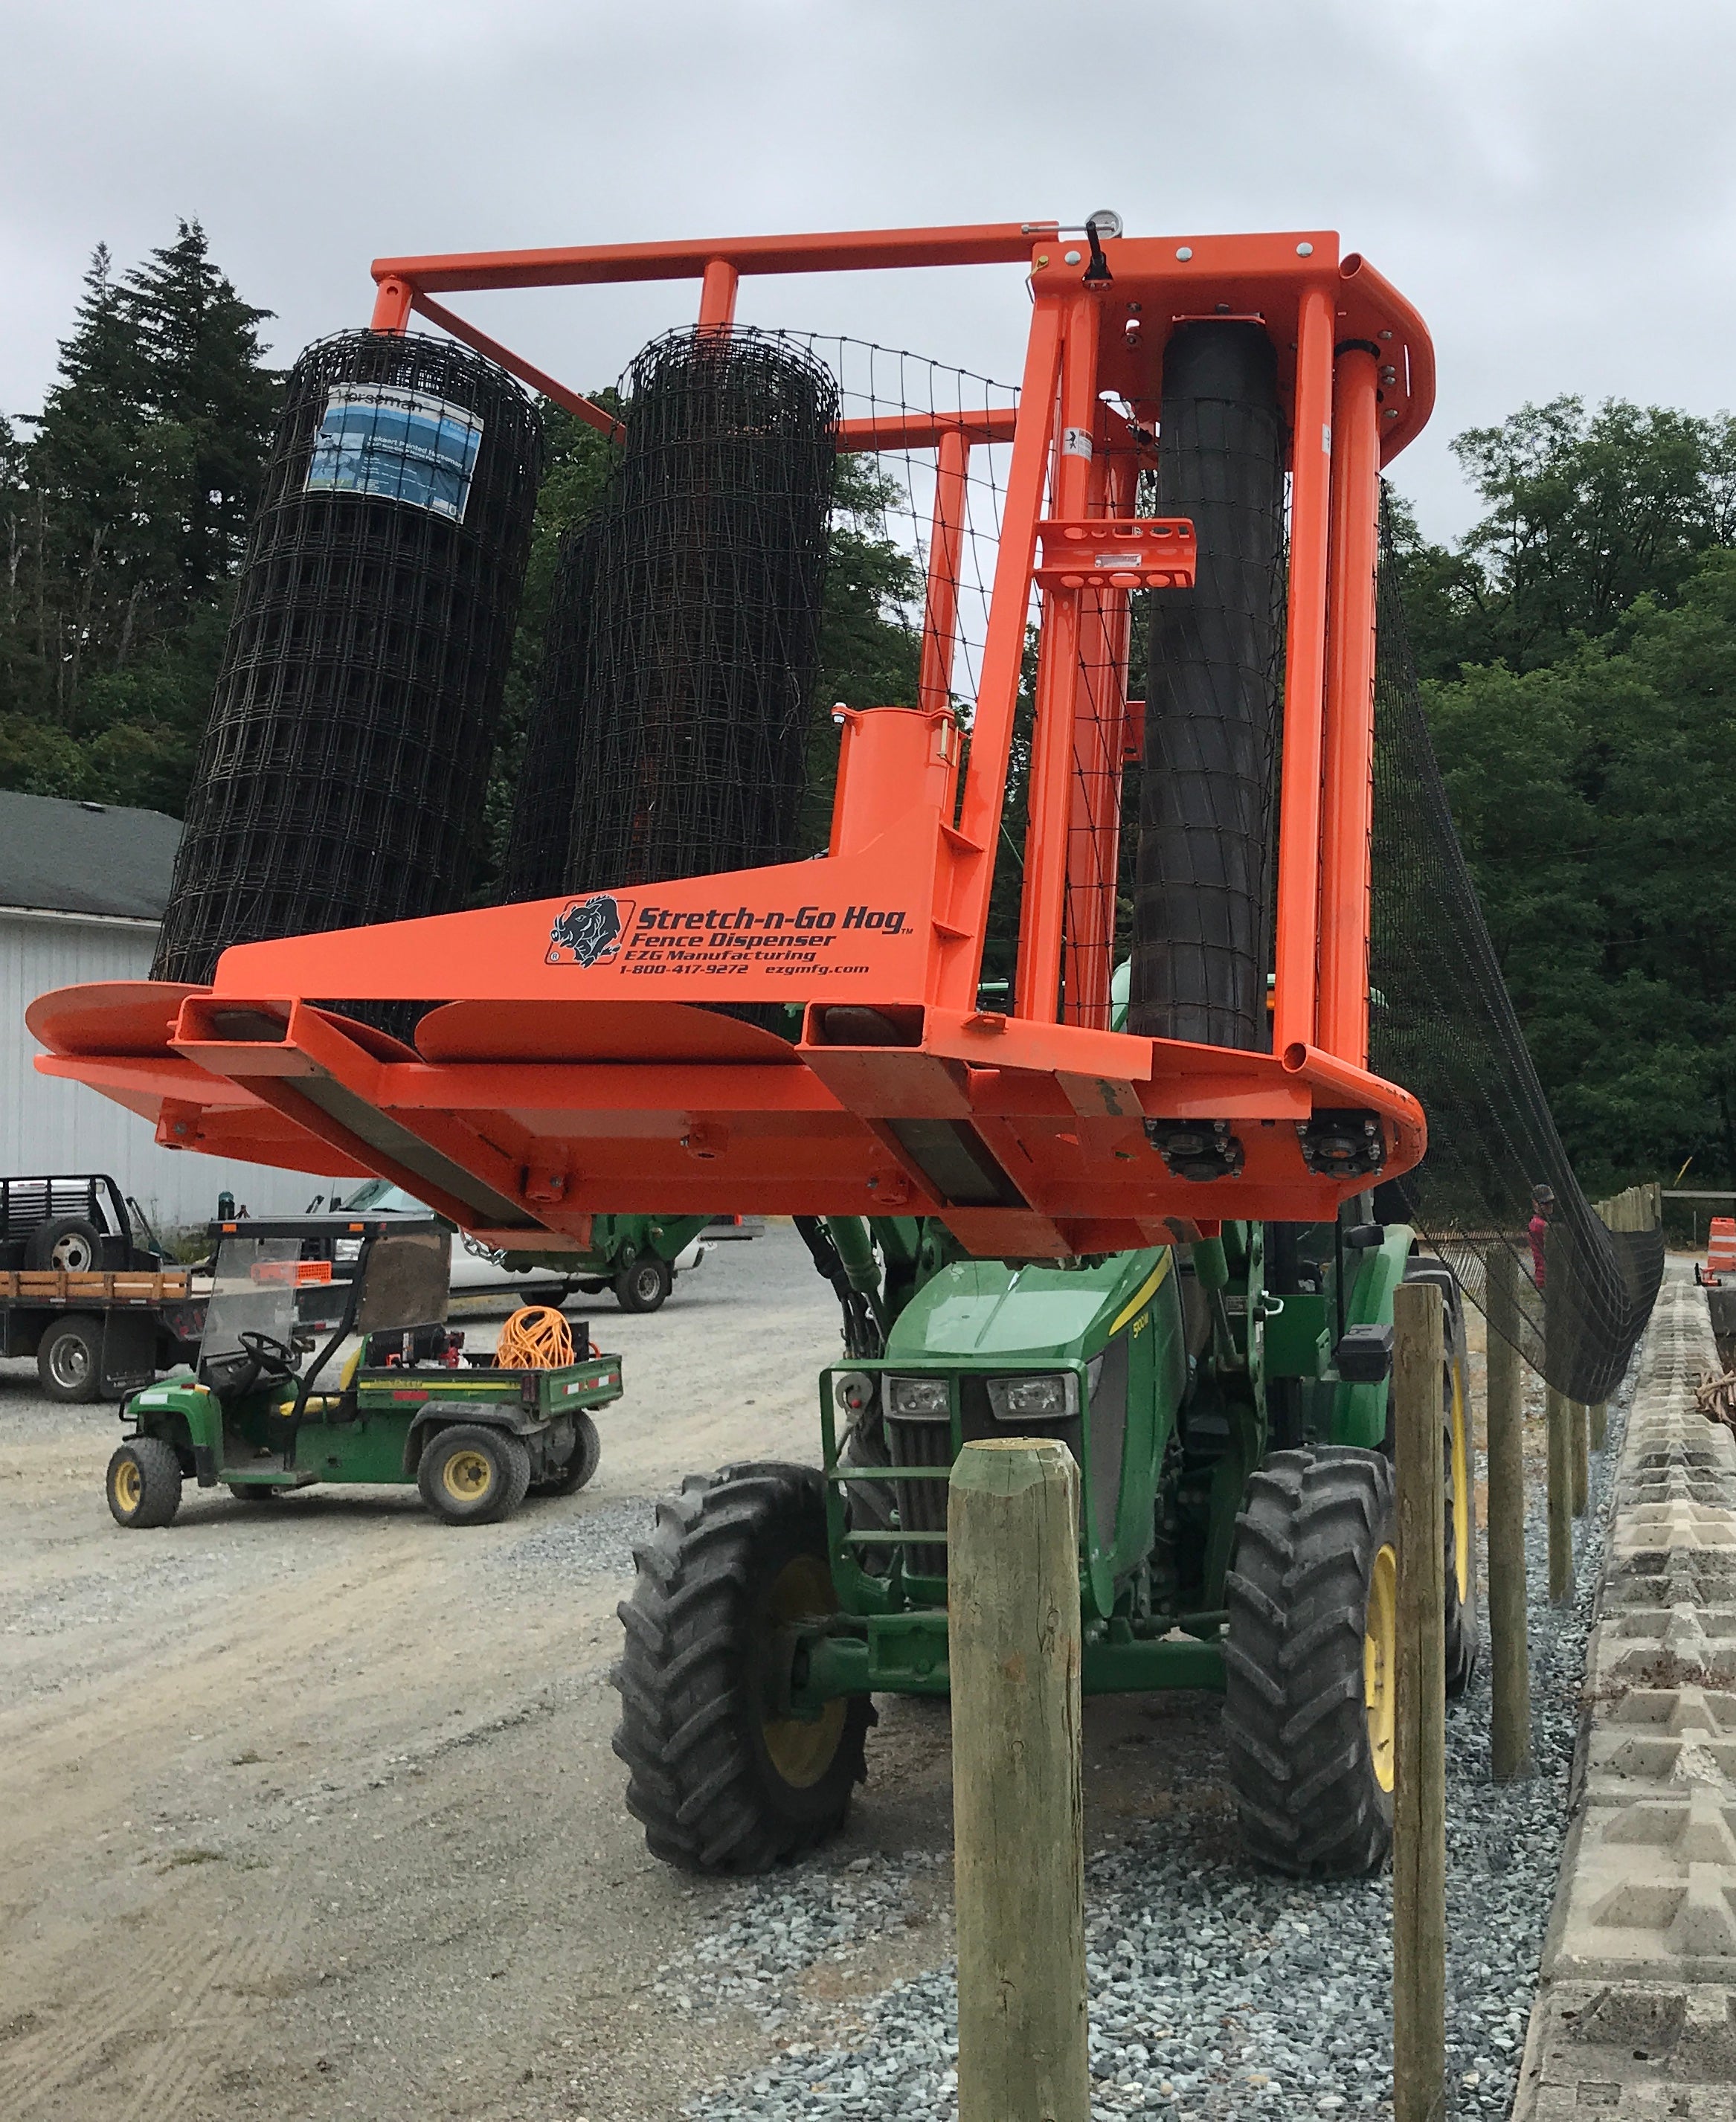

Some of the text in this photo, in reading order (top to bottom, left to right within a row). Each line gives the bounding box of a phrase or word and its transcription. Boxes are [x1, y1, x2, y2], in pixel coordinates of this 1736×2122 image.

[636, 907, 836, 930] Stretch-n-Go
[841, 906, 906, 935] Hog
[630, 933, 837, 950] Fence Dispenser
[624, 950, 817, 962] EZG Manufacturing
[620, 964, 869, 975] 1-800-417-9272 ezgmfg.com
